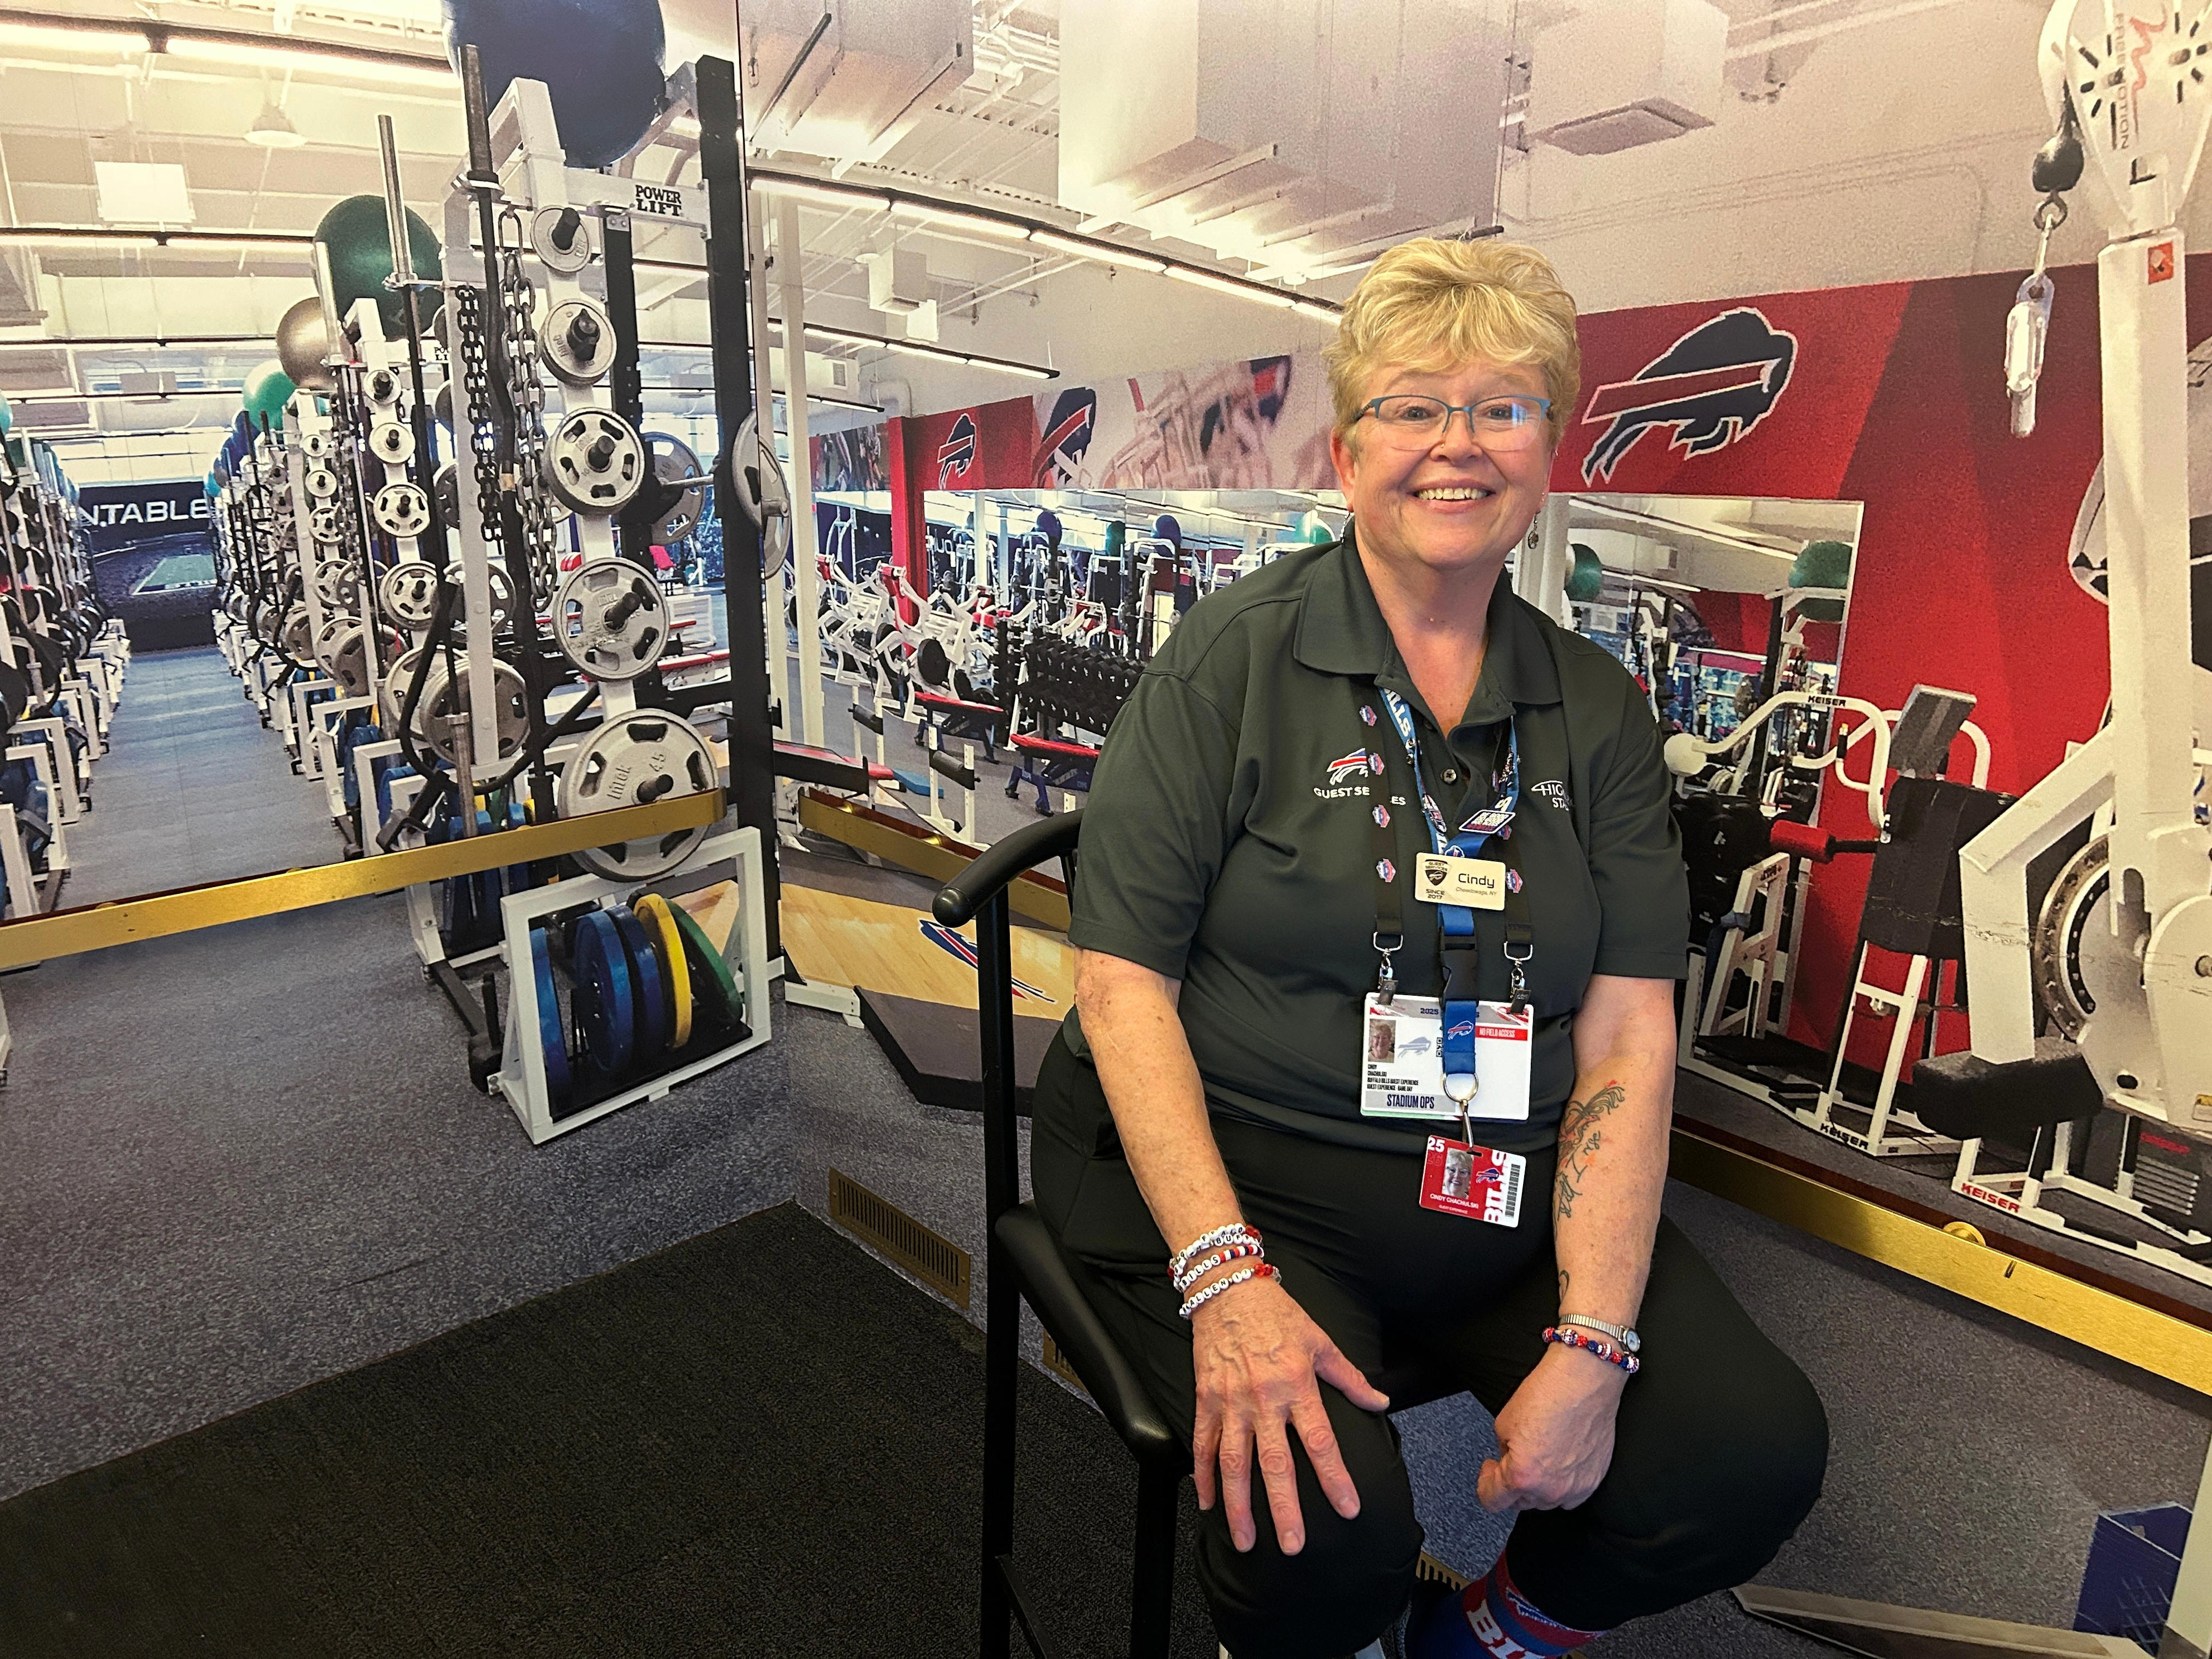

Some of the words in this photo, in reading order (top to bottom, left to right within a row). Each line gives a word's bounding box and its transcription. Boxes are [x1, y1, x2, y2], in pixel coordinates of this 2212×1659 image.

[635, 184, 682, 205] POWER
[637, 199, 683, 217] LIFT
[1808, 694, 1847, 708] KEISER
[1313, 787, 1353, 799] GUEST
[1458, 873, 1495, 889] Cindy
[1486, 1028, 1498, 1037] FIELD
[1498, 1029, 1516, 1038] ACCESS
[1386, 1093, 1418, 1108] STADIUM
[1419, 1096, 1434, 1109] OPS
[1820, 1122, 1869, 1150] KEISER
[1427, 1137, 1445, 1153] 25
[1429, 1193, 1447, 1202] CINDY
[1960, 1182, 2020, 1213] KEISER
[1181, 1256, 1219, 1286] BILLS
[1189, 1279, 1227, 1307] ALLEN
